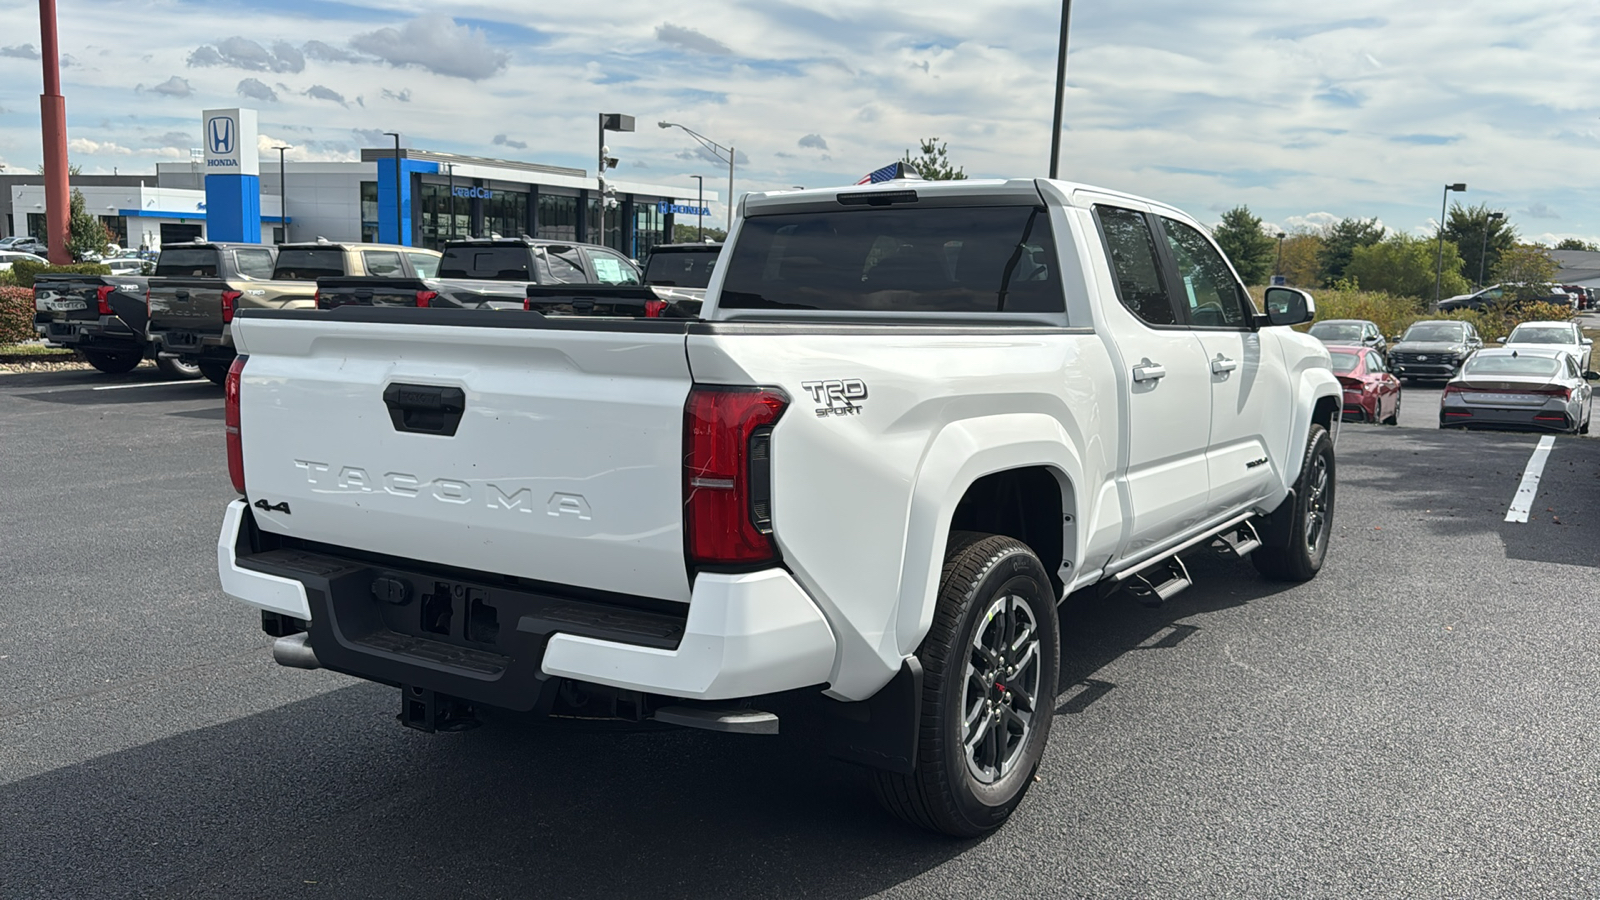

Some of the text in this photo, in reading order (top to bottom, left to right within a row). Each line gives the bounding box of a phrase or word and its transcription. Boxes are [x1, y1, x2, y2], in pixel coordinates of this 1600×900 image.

[207, 159, 238, 167] HONDA
[452, 186, 493, 199] LeadCar
[801, 378, 868, 406] TRD
[815, 405, 863, 418] SPORT
[294, 459, 592, 520] TACOMA
